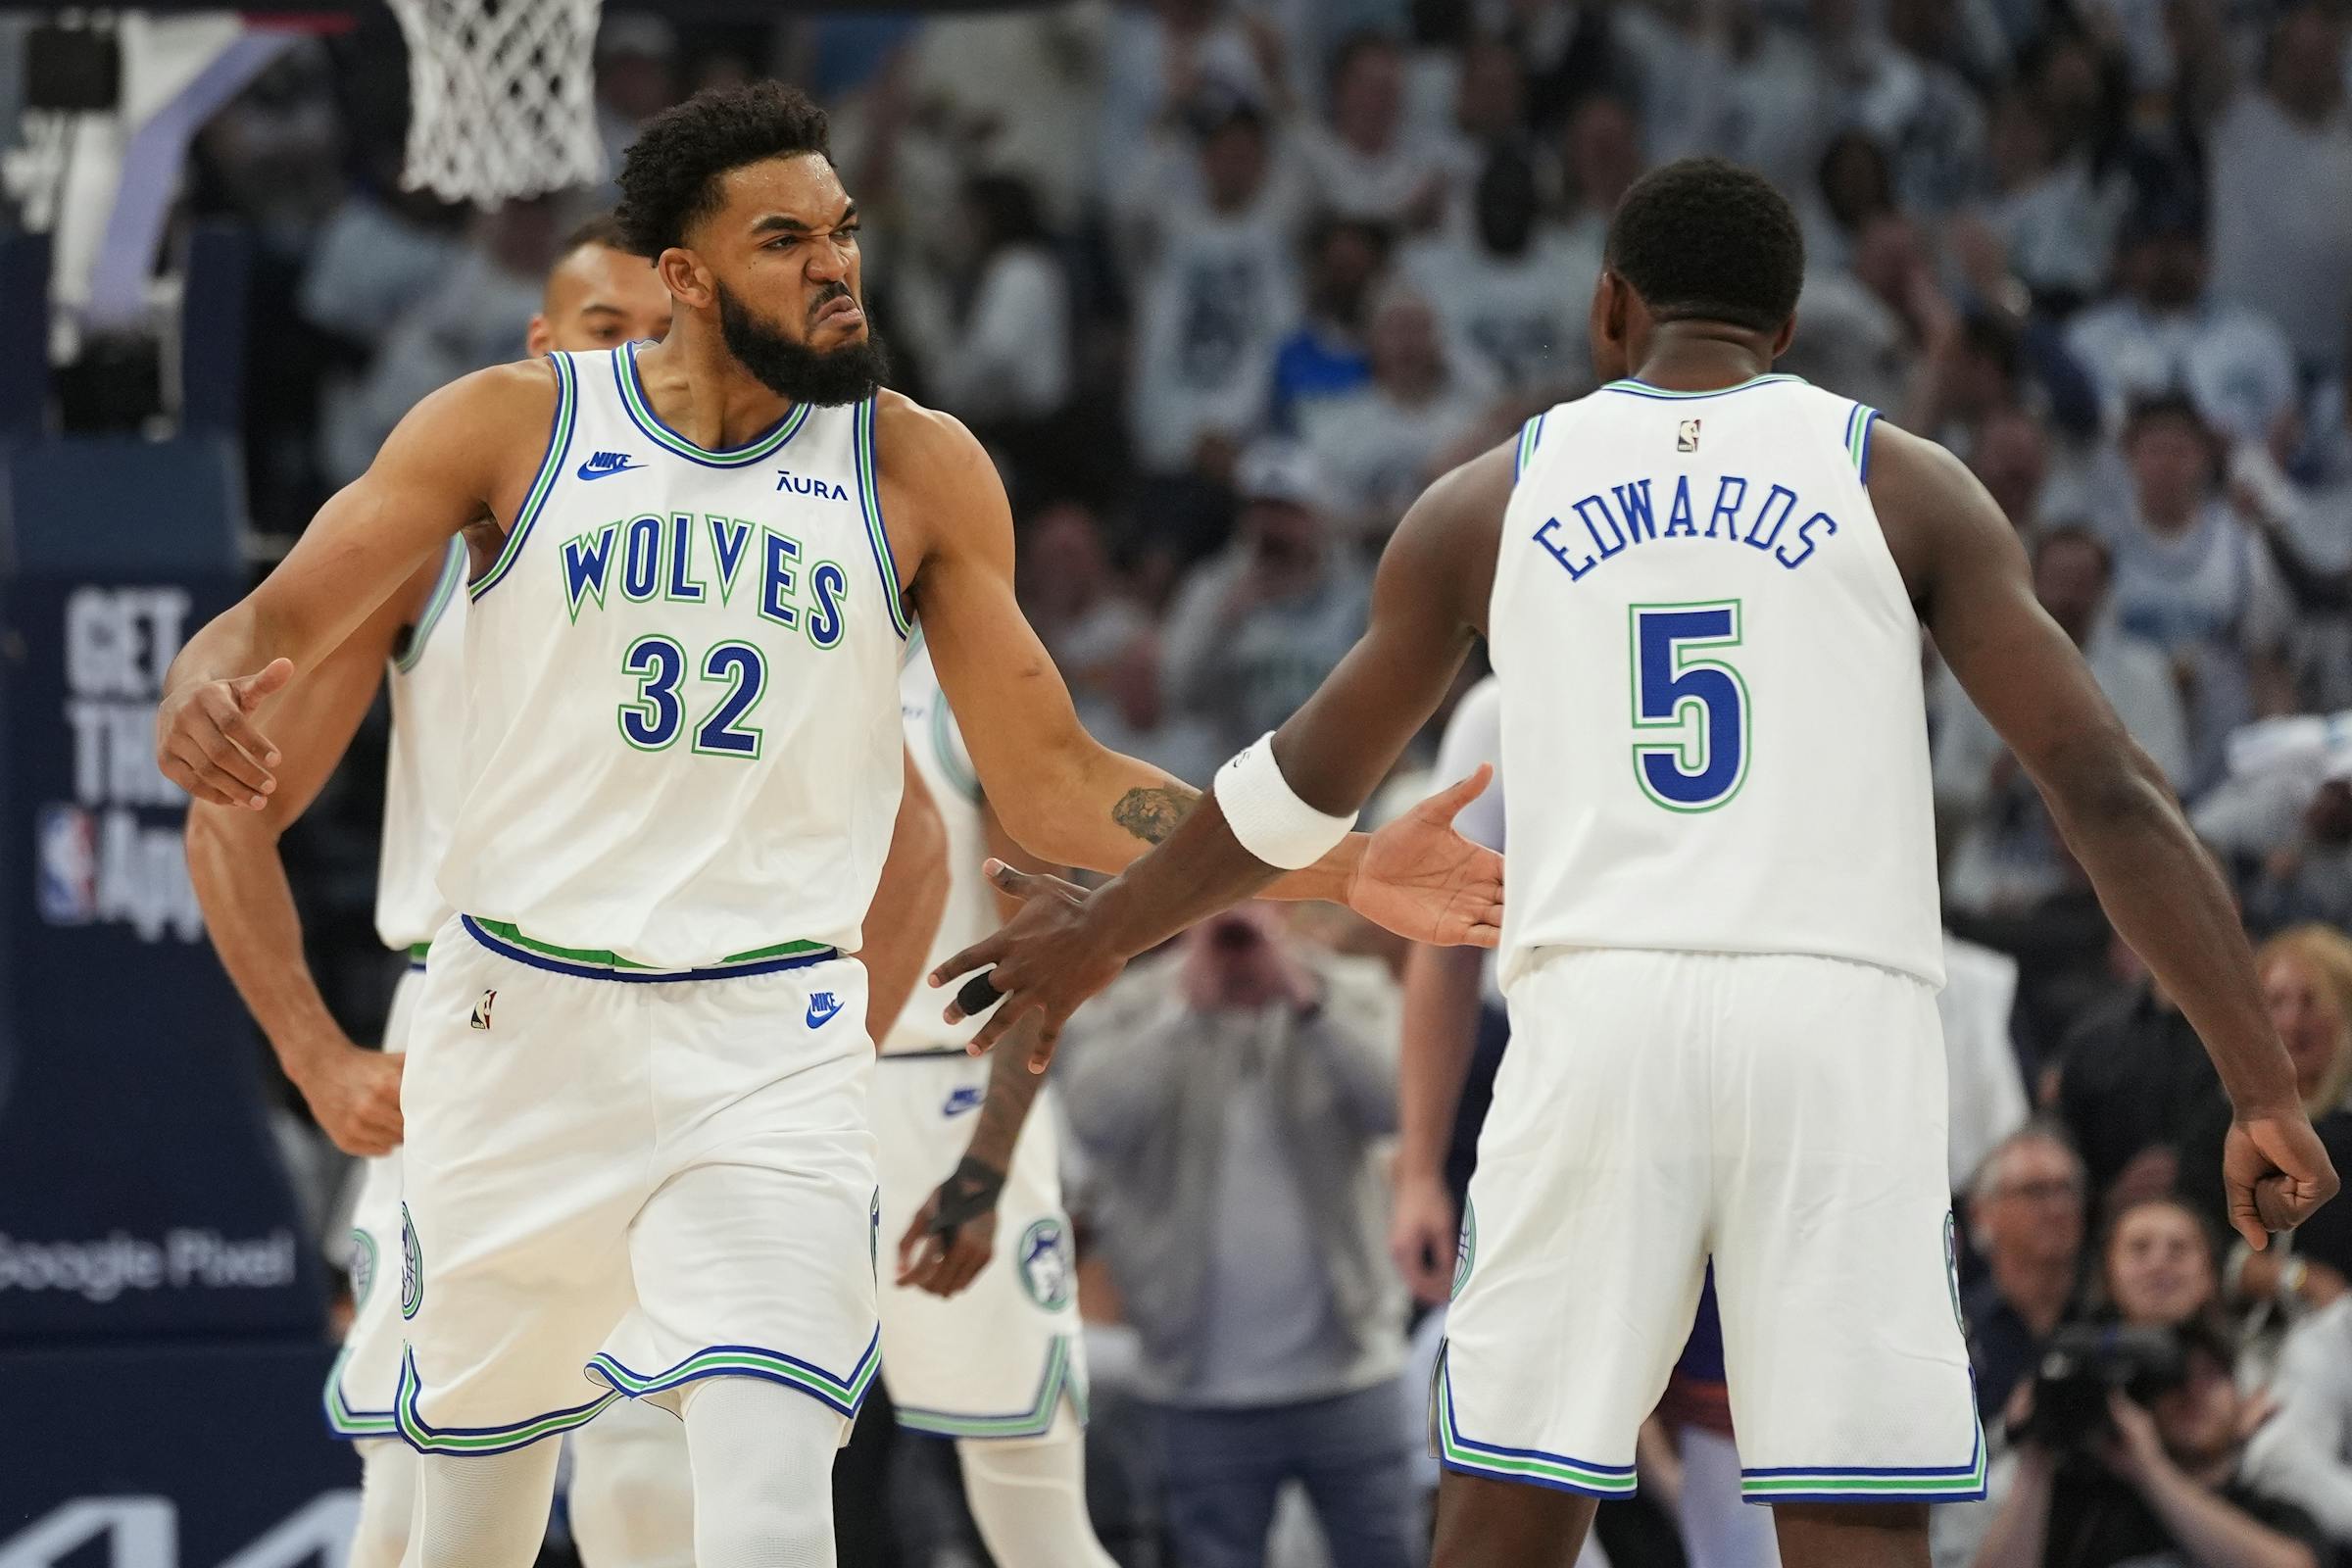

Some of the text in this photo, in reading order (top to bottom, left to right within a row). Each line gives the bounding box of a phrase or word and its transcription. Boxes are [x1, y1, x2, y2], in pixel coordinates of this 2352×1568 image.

[589, 451, 632, 469] NIKE
[560, 511, 849, 651] WOLVES
[1532, 475, 1838, 582] EDWARDS
[617, 633, 768, 760] 32
[1629, 599, 1751, 813] 5
[66, 700, 188, 808] TH
[809, 992, 837, 1012] NIKE
